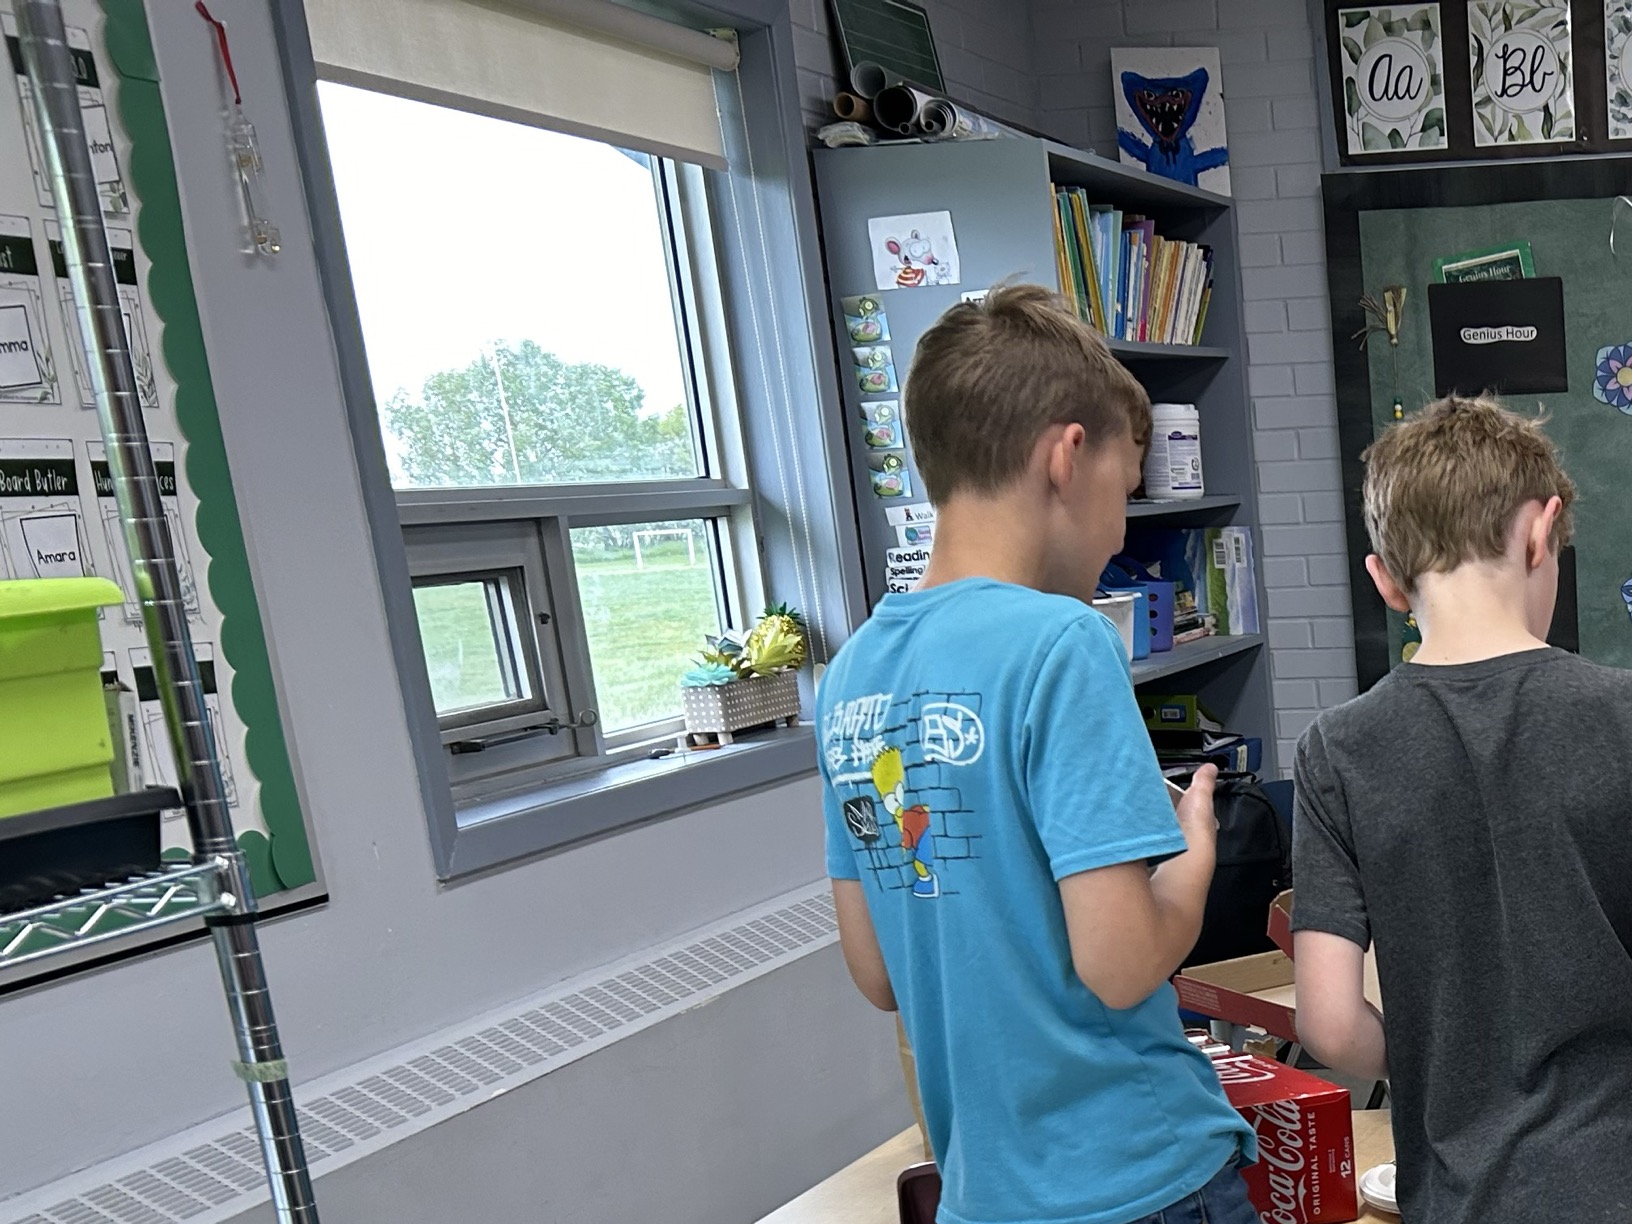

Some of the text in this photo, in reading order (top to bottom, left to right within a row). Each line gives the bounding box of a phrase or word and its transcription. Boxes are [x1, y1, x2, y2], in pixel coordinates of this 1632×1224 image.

[1368, 54, 1423, 102] Aa
[1494, 43, 1554, 98] Bb
[1463, 327, 1534, 340] Genius Hour
[34, 468, 69, 493] Butler
[37, 548, 77, 566] Amara
[1308, 1112, 1321, 1216] ORIGINAL TASTE
[1341, 1160, 1352, 1179] 12
